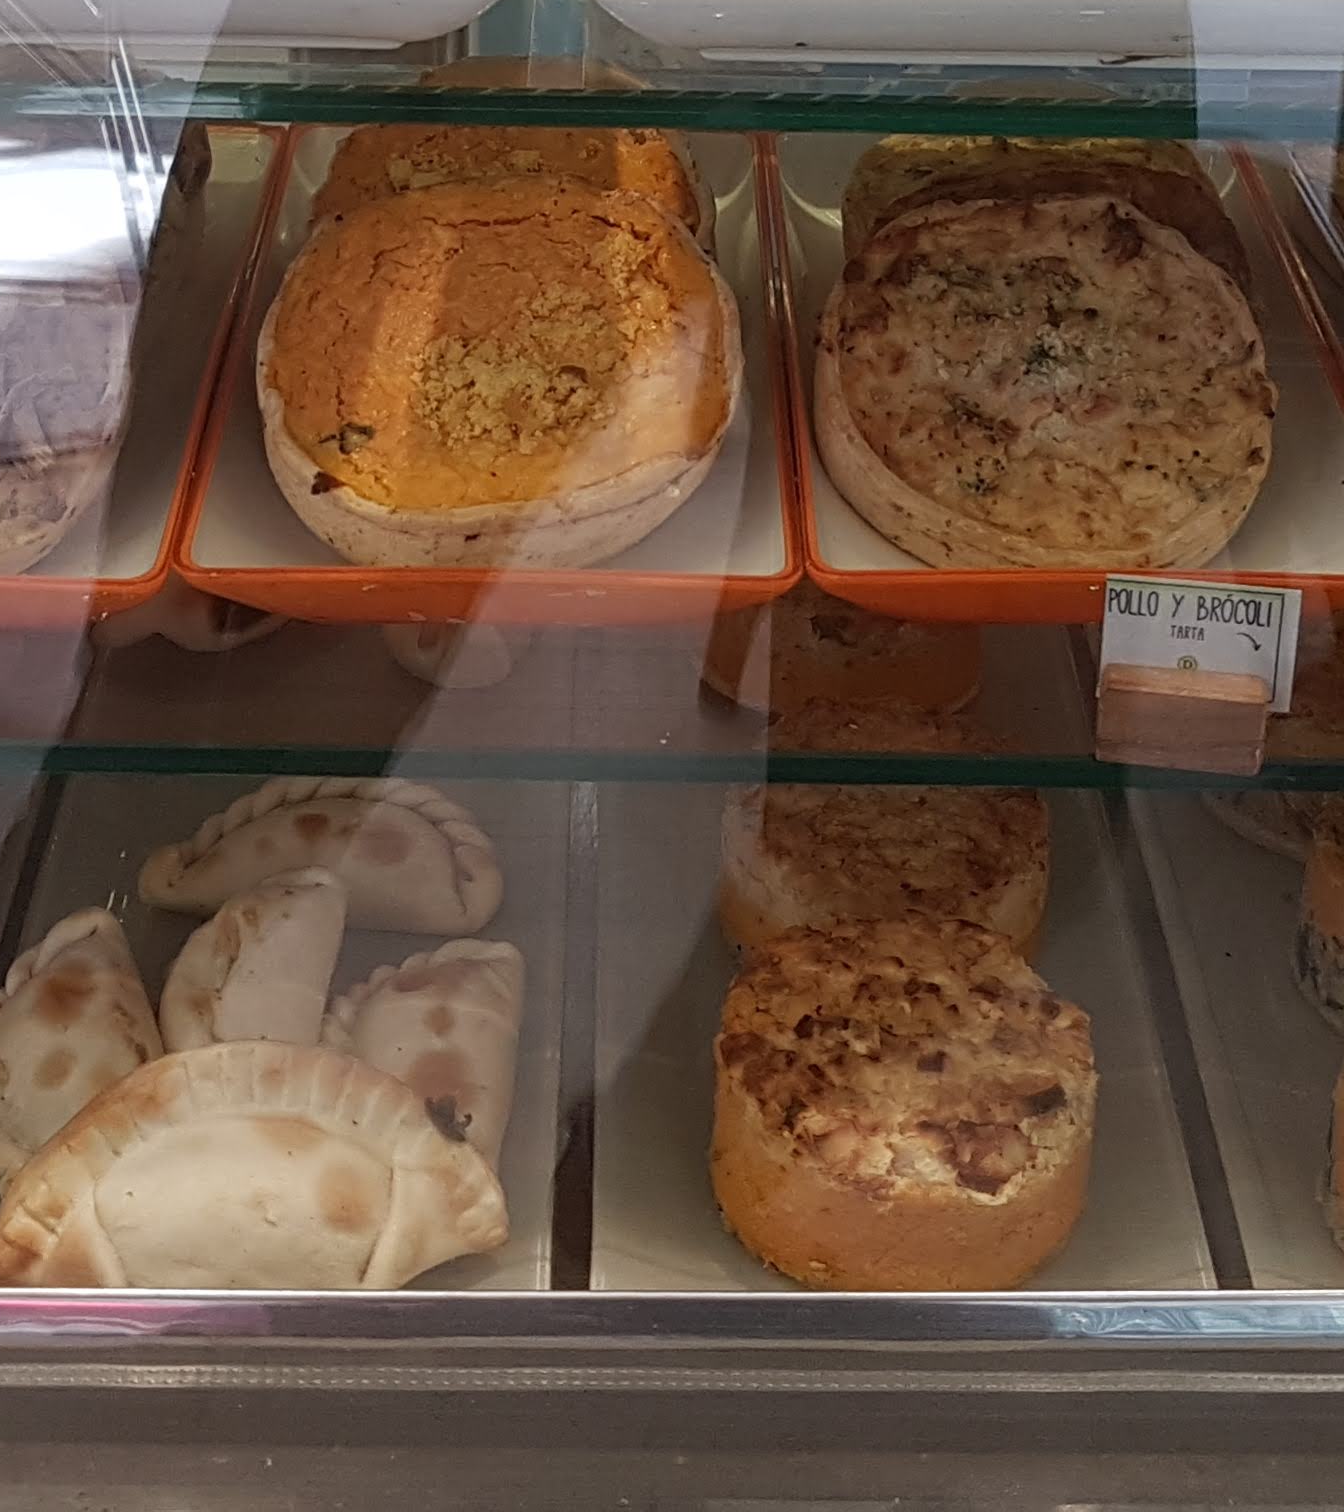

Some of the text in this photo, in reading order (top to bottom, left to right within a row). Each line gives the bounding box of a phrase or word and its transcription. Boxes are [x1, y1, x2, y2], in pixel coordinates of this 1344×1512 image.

[1108, 587, 1273, 628] POLLO Y BRÓCOLI
[1170, 624, 1205, 641] TARTA
